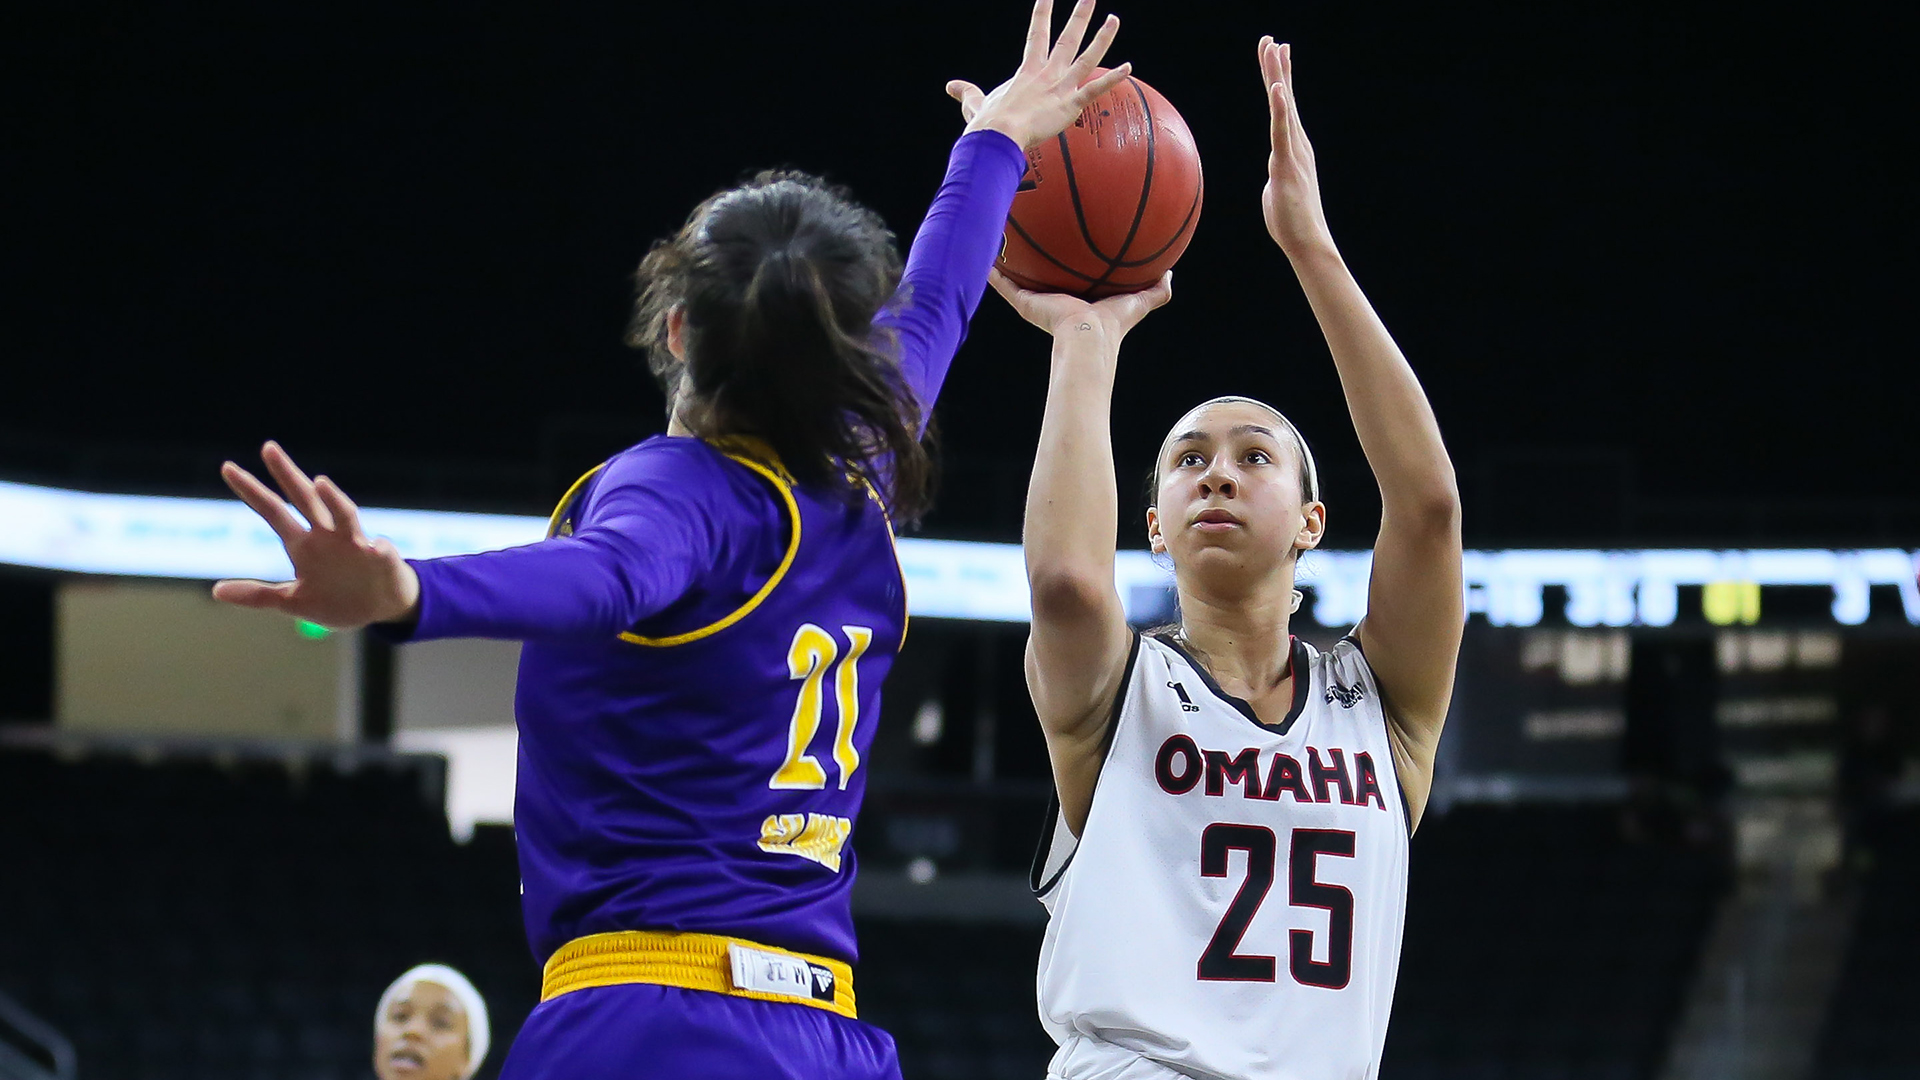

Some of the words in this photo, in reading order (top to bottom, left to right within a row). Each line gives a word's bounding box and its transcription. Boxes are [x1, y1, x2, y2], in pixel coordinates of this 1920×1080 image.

[768, 622, 874, 791] 21
[1154, 733, 1387, 811] OMAHA
[1197, 822, 1356, 990] 25
